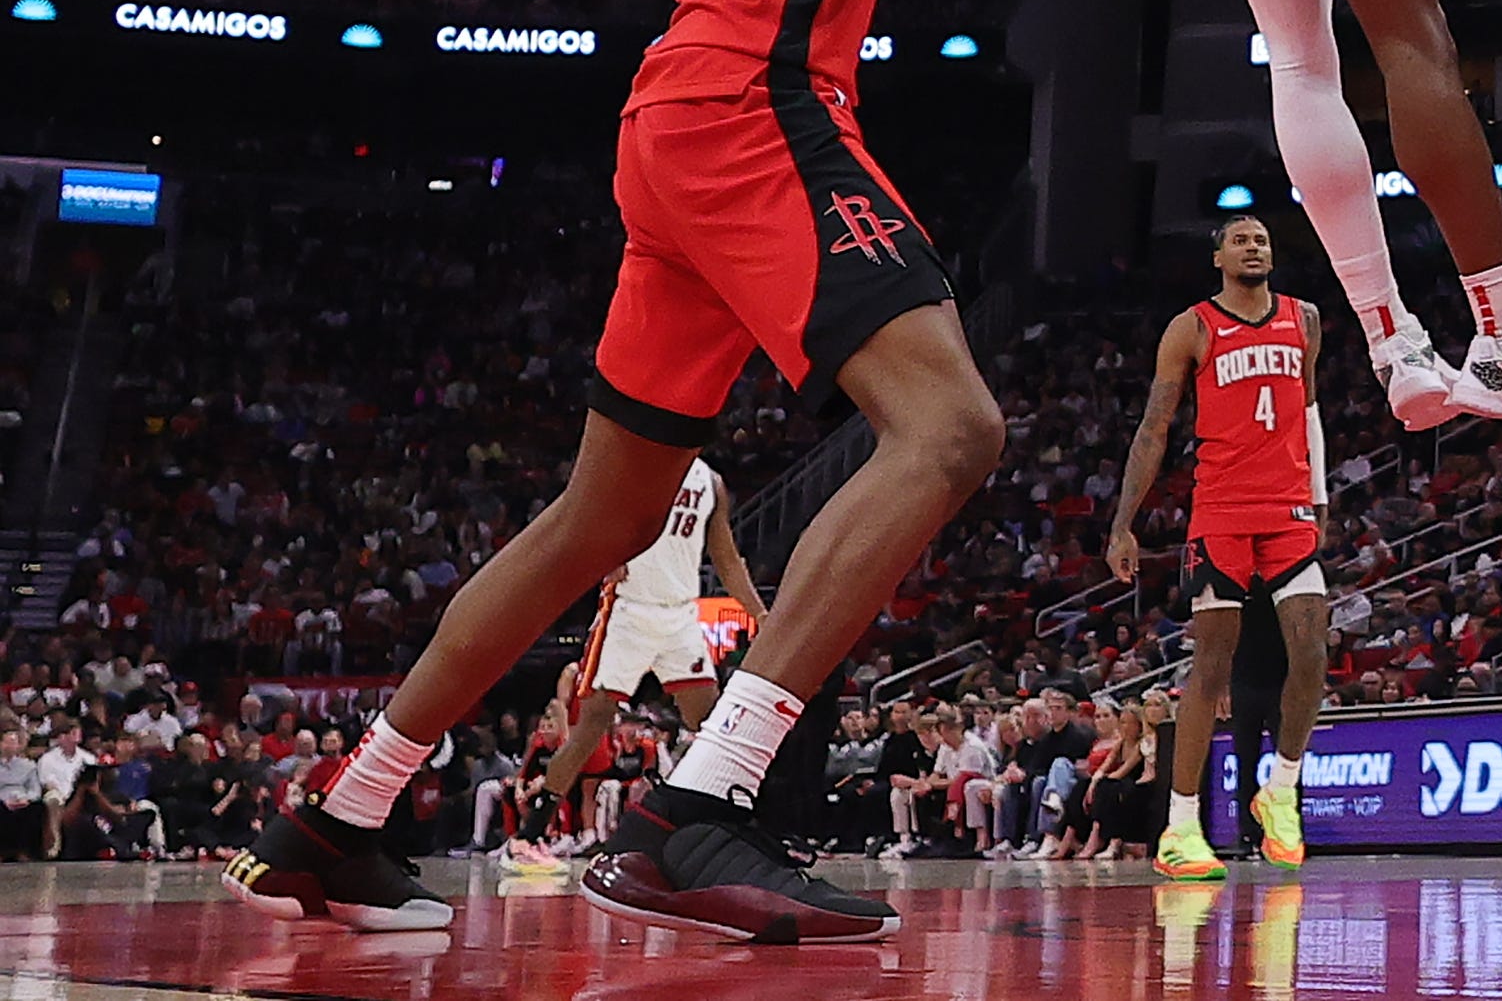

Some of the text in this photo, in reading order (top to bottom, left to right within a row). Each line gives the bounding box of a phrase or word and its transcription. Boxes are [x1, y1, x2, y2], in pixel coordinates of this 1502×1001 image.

[117, 4, 286, 40] CASAMIGOS
[438, 27, 595, 55] CASAMIGOS
[1214, 343, 1304, 388] ROCKETS
[1254, 385, 1276, 432] 4
[670, 511, 698, 539] 18
